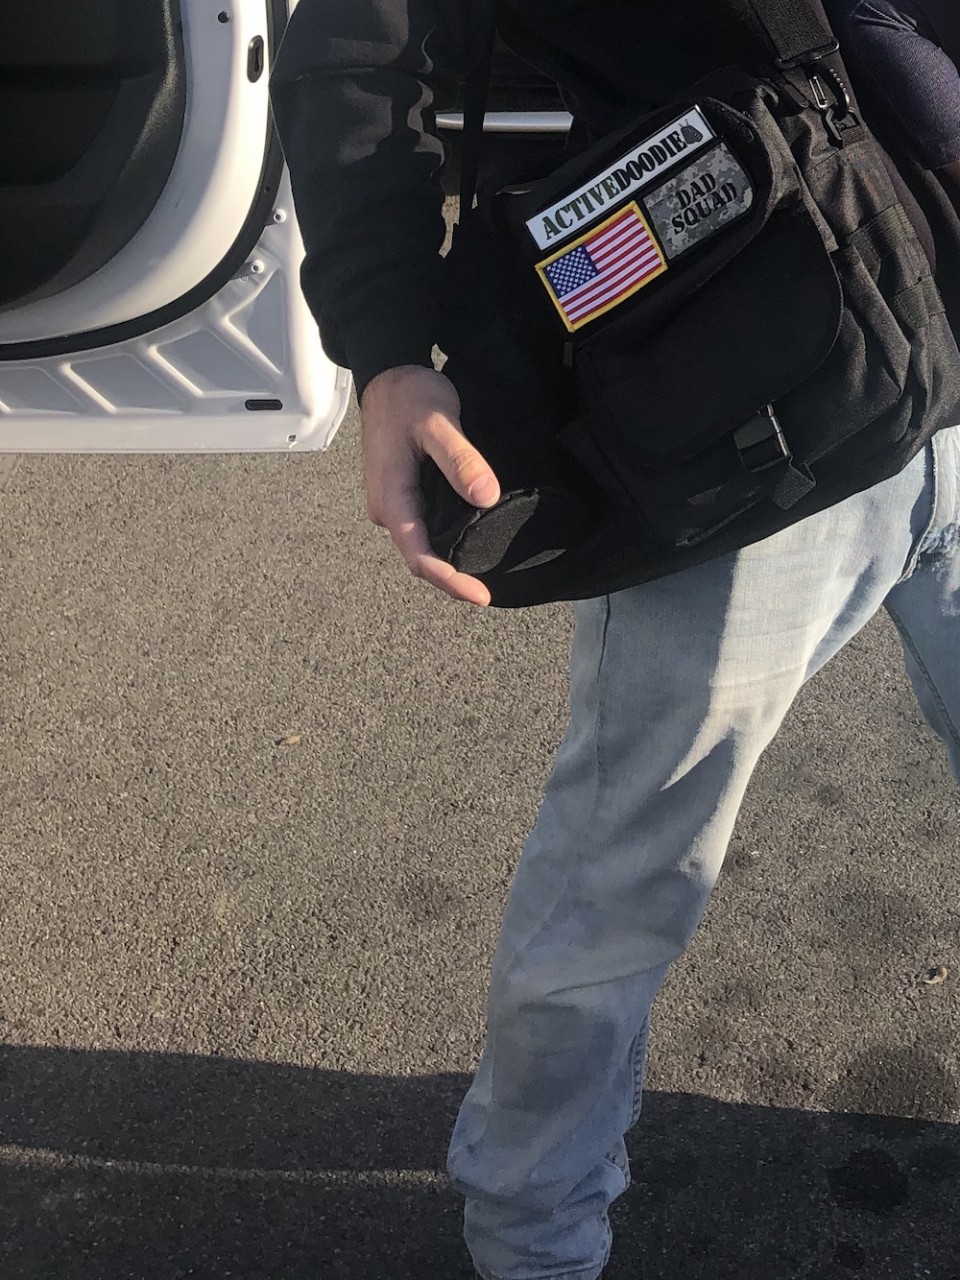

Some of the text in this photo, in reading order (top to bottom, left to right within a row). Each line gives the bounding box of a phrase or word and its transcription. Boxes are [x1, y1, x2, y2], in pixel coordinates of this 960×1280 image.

[541, 130, 687, 240] ACTIVEDOODIE
[671, 182, 738, 236] SQUAD
[675, 172, 717, 210] DAD
